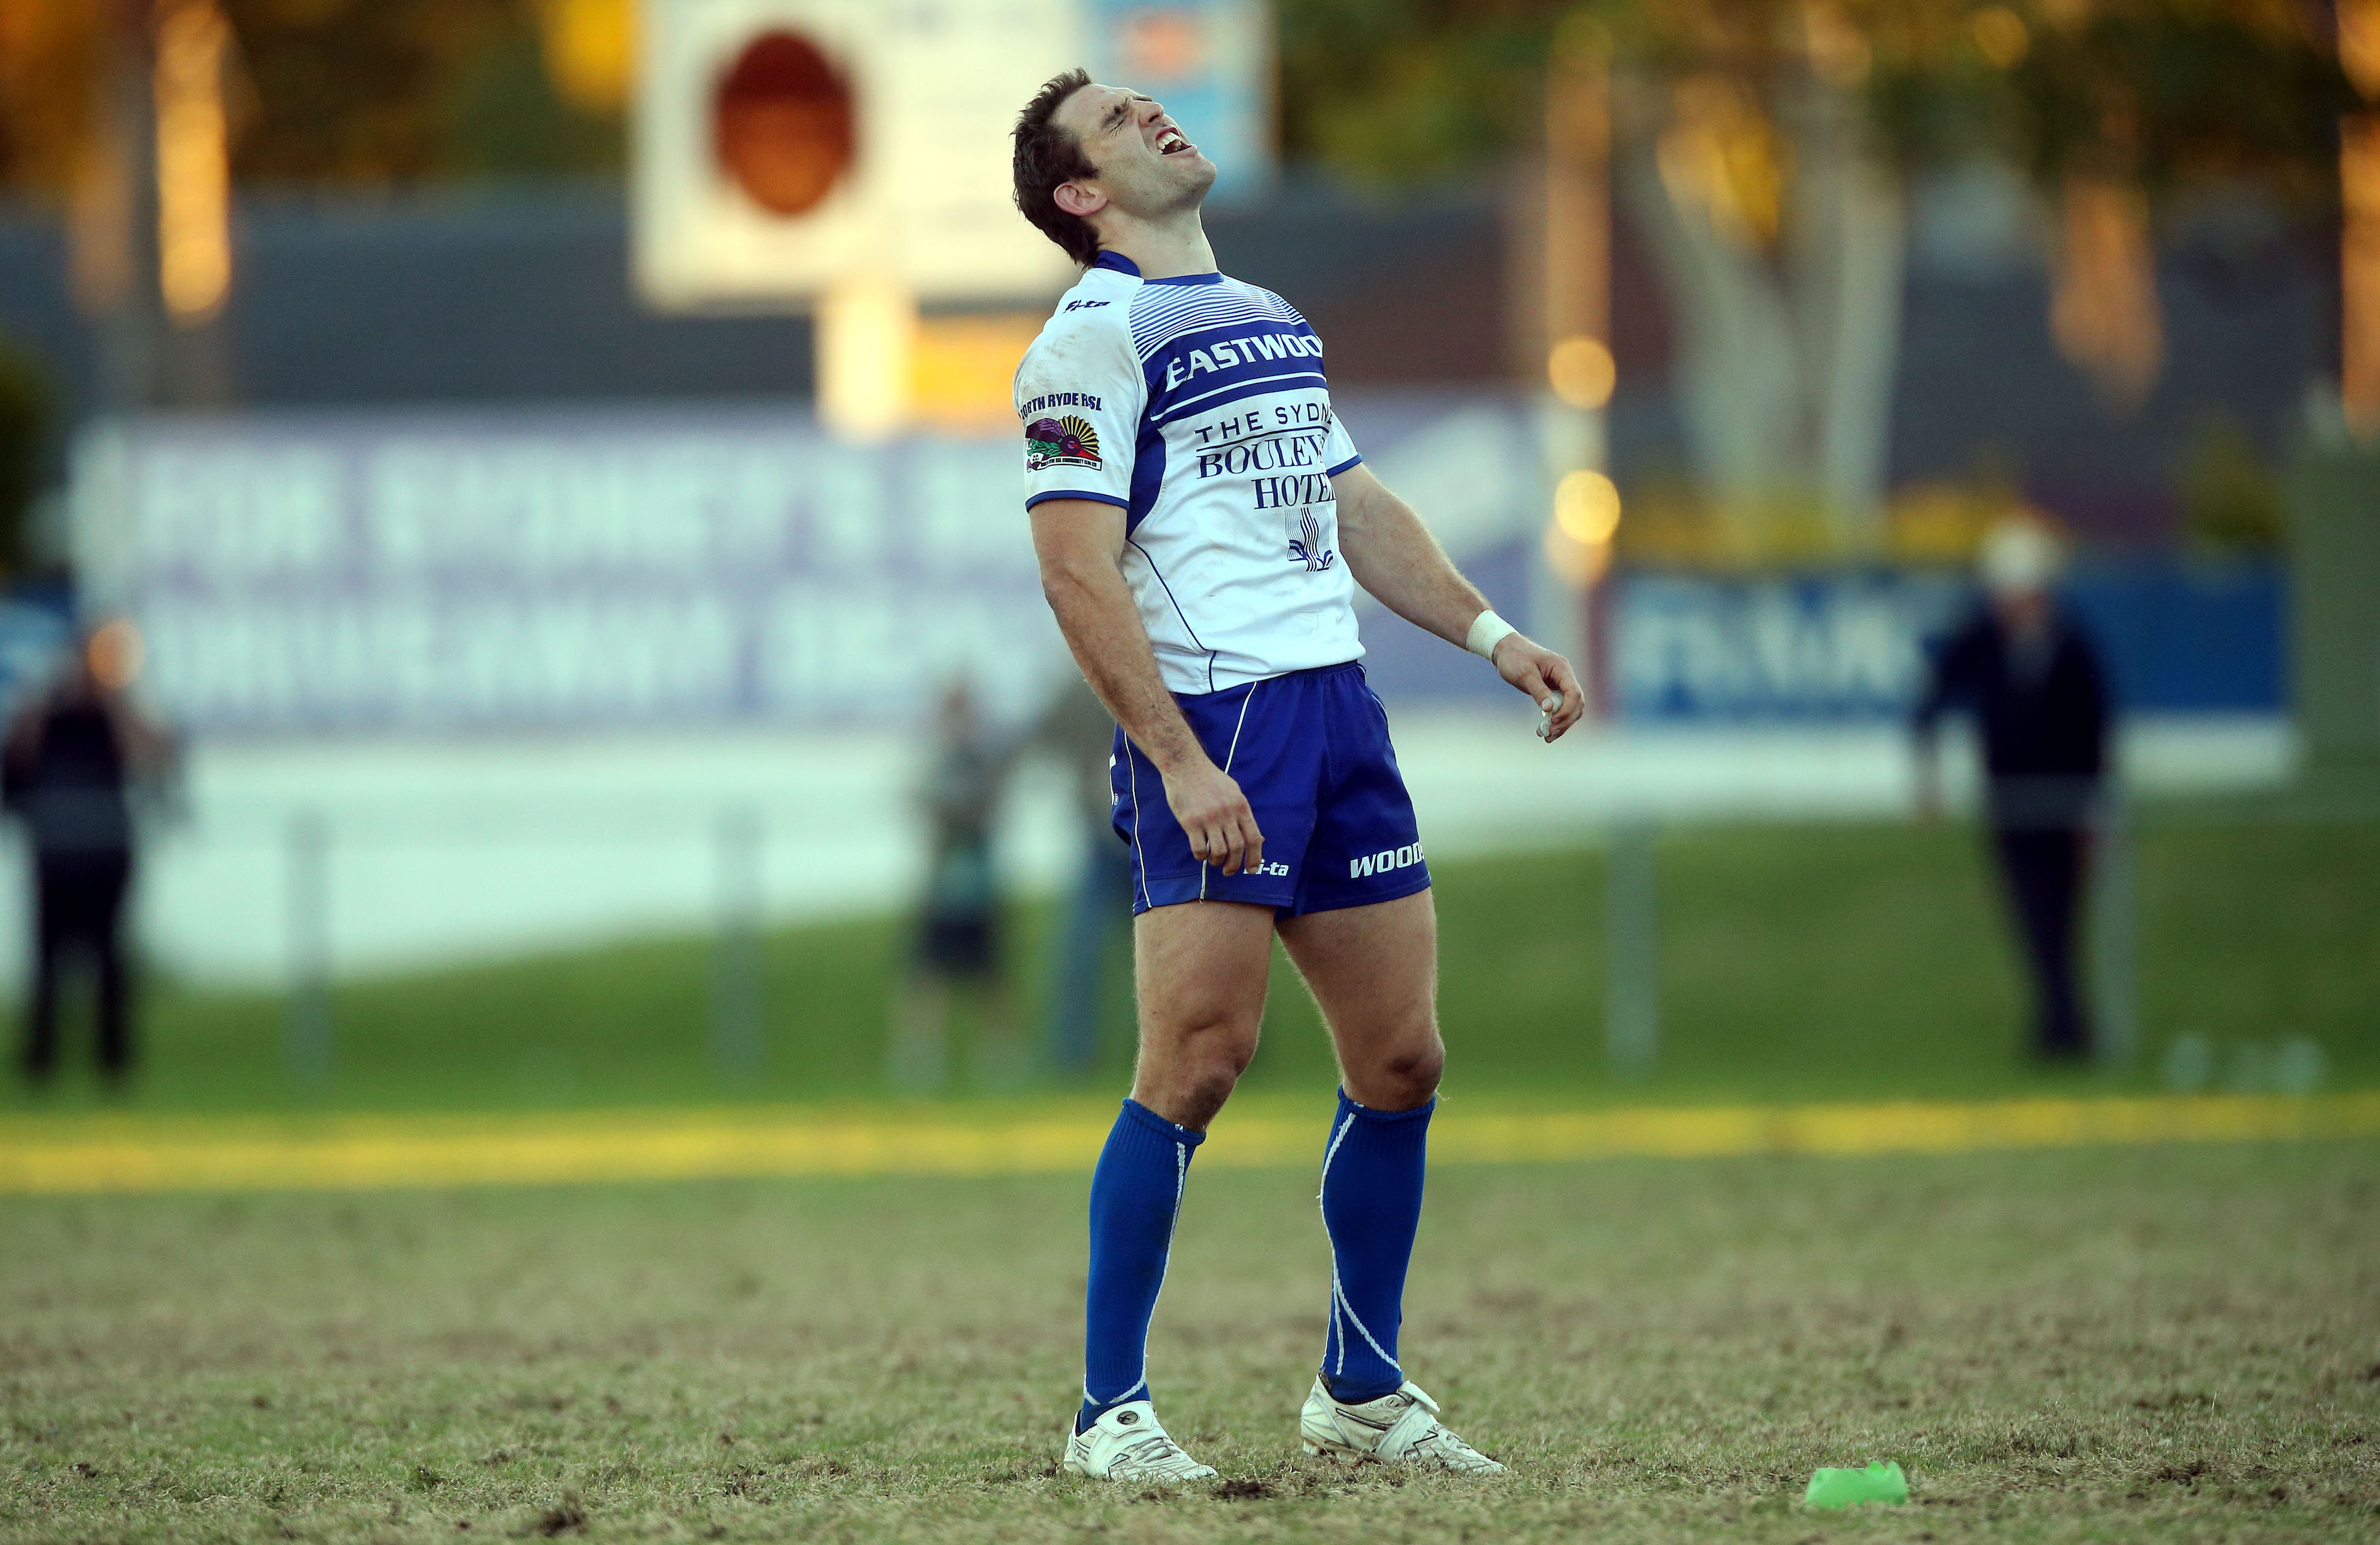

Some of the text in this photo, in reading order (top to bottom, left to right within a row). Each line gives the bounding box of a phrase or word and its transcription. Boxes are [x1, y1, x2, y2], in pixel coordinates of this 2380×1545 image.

[1048, 392, 1079, 408] RYDE
[1081, 393, 1102, 411] RSL
[1195, 411, 1263, 443] THE
[1243, 858, 1289, 877] i-ta
